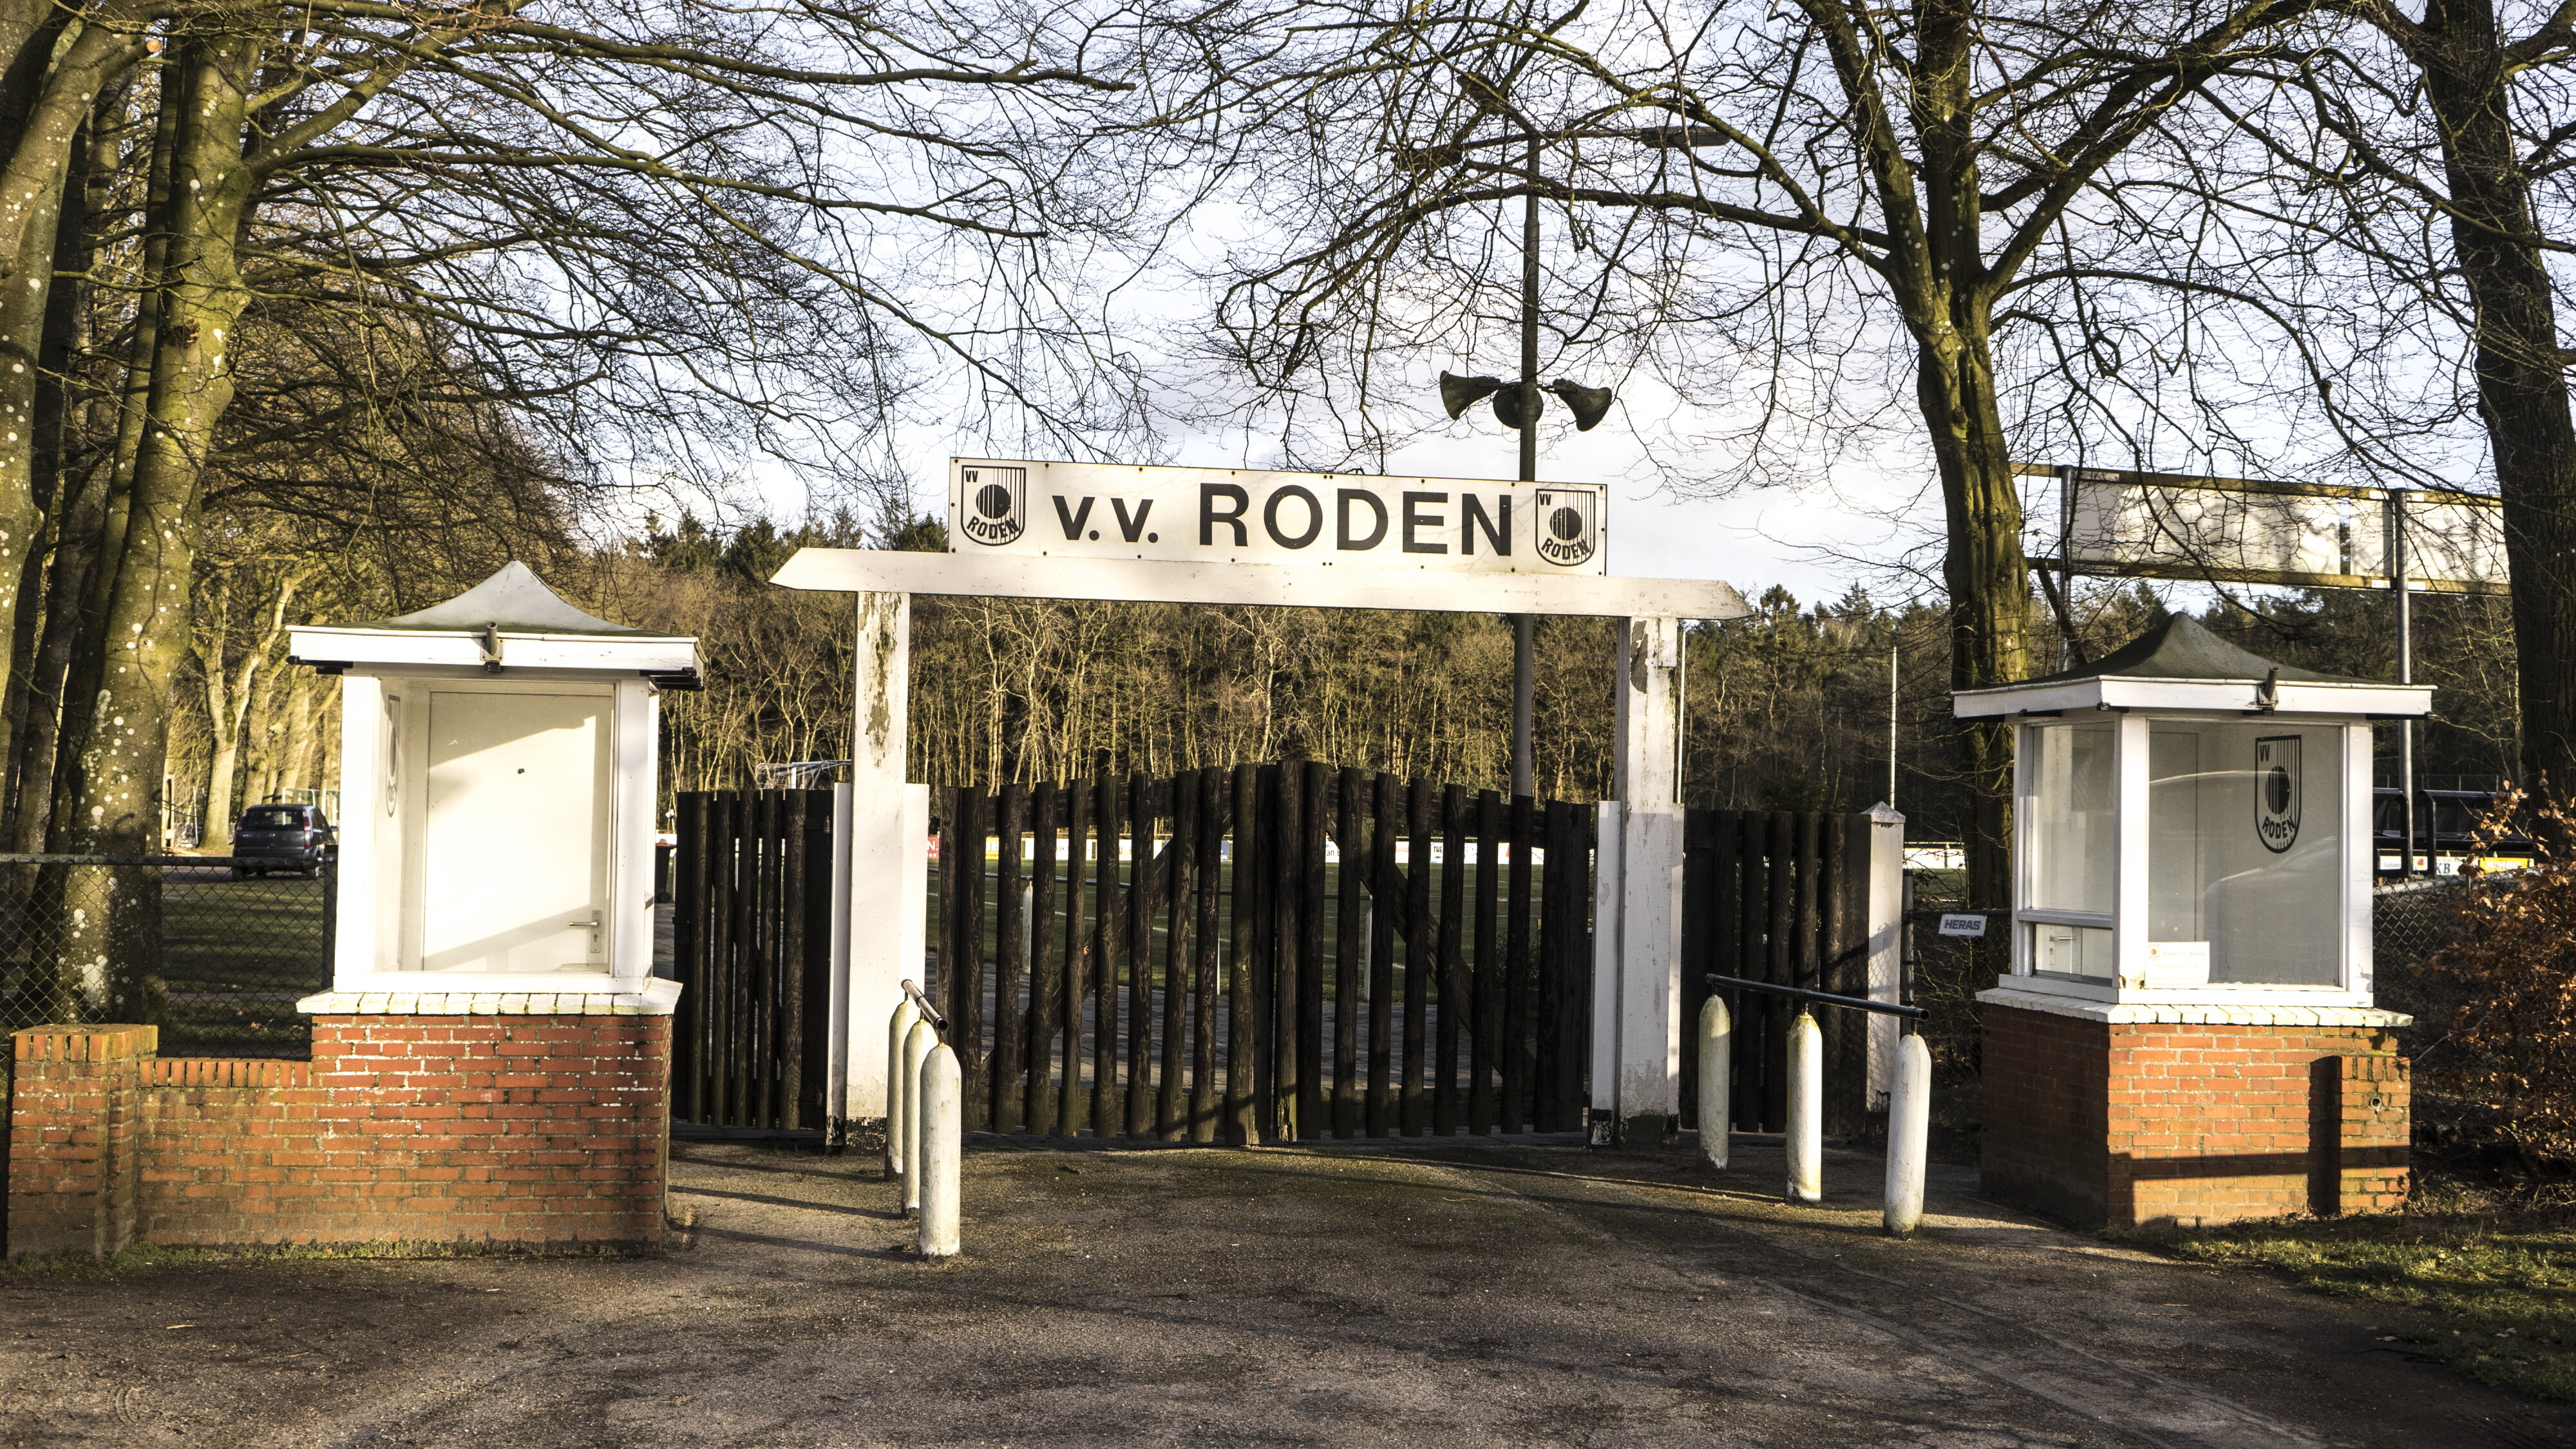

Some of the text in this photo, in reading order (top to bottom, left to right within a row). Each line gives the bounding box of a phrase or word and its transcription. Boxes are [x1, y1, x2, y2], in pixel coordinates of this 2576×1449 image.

[965, 470, 978, 482] VV
[1539, 493, 1551, 506] VV
[967, 515, 1019, 539] RODEN
[1199, 482, 1511, 557] RODEN
[1541, 537, 1590, 560] RODEN
[2259, 744, 2270, 762] VV
[2262, 815, 2297, 839] RODEN
[2486, 860, 2521, 869] JUMBO
[1944, 919, 1981, 931] HERAS
